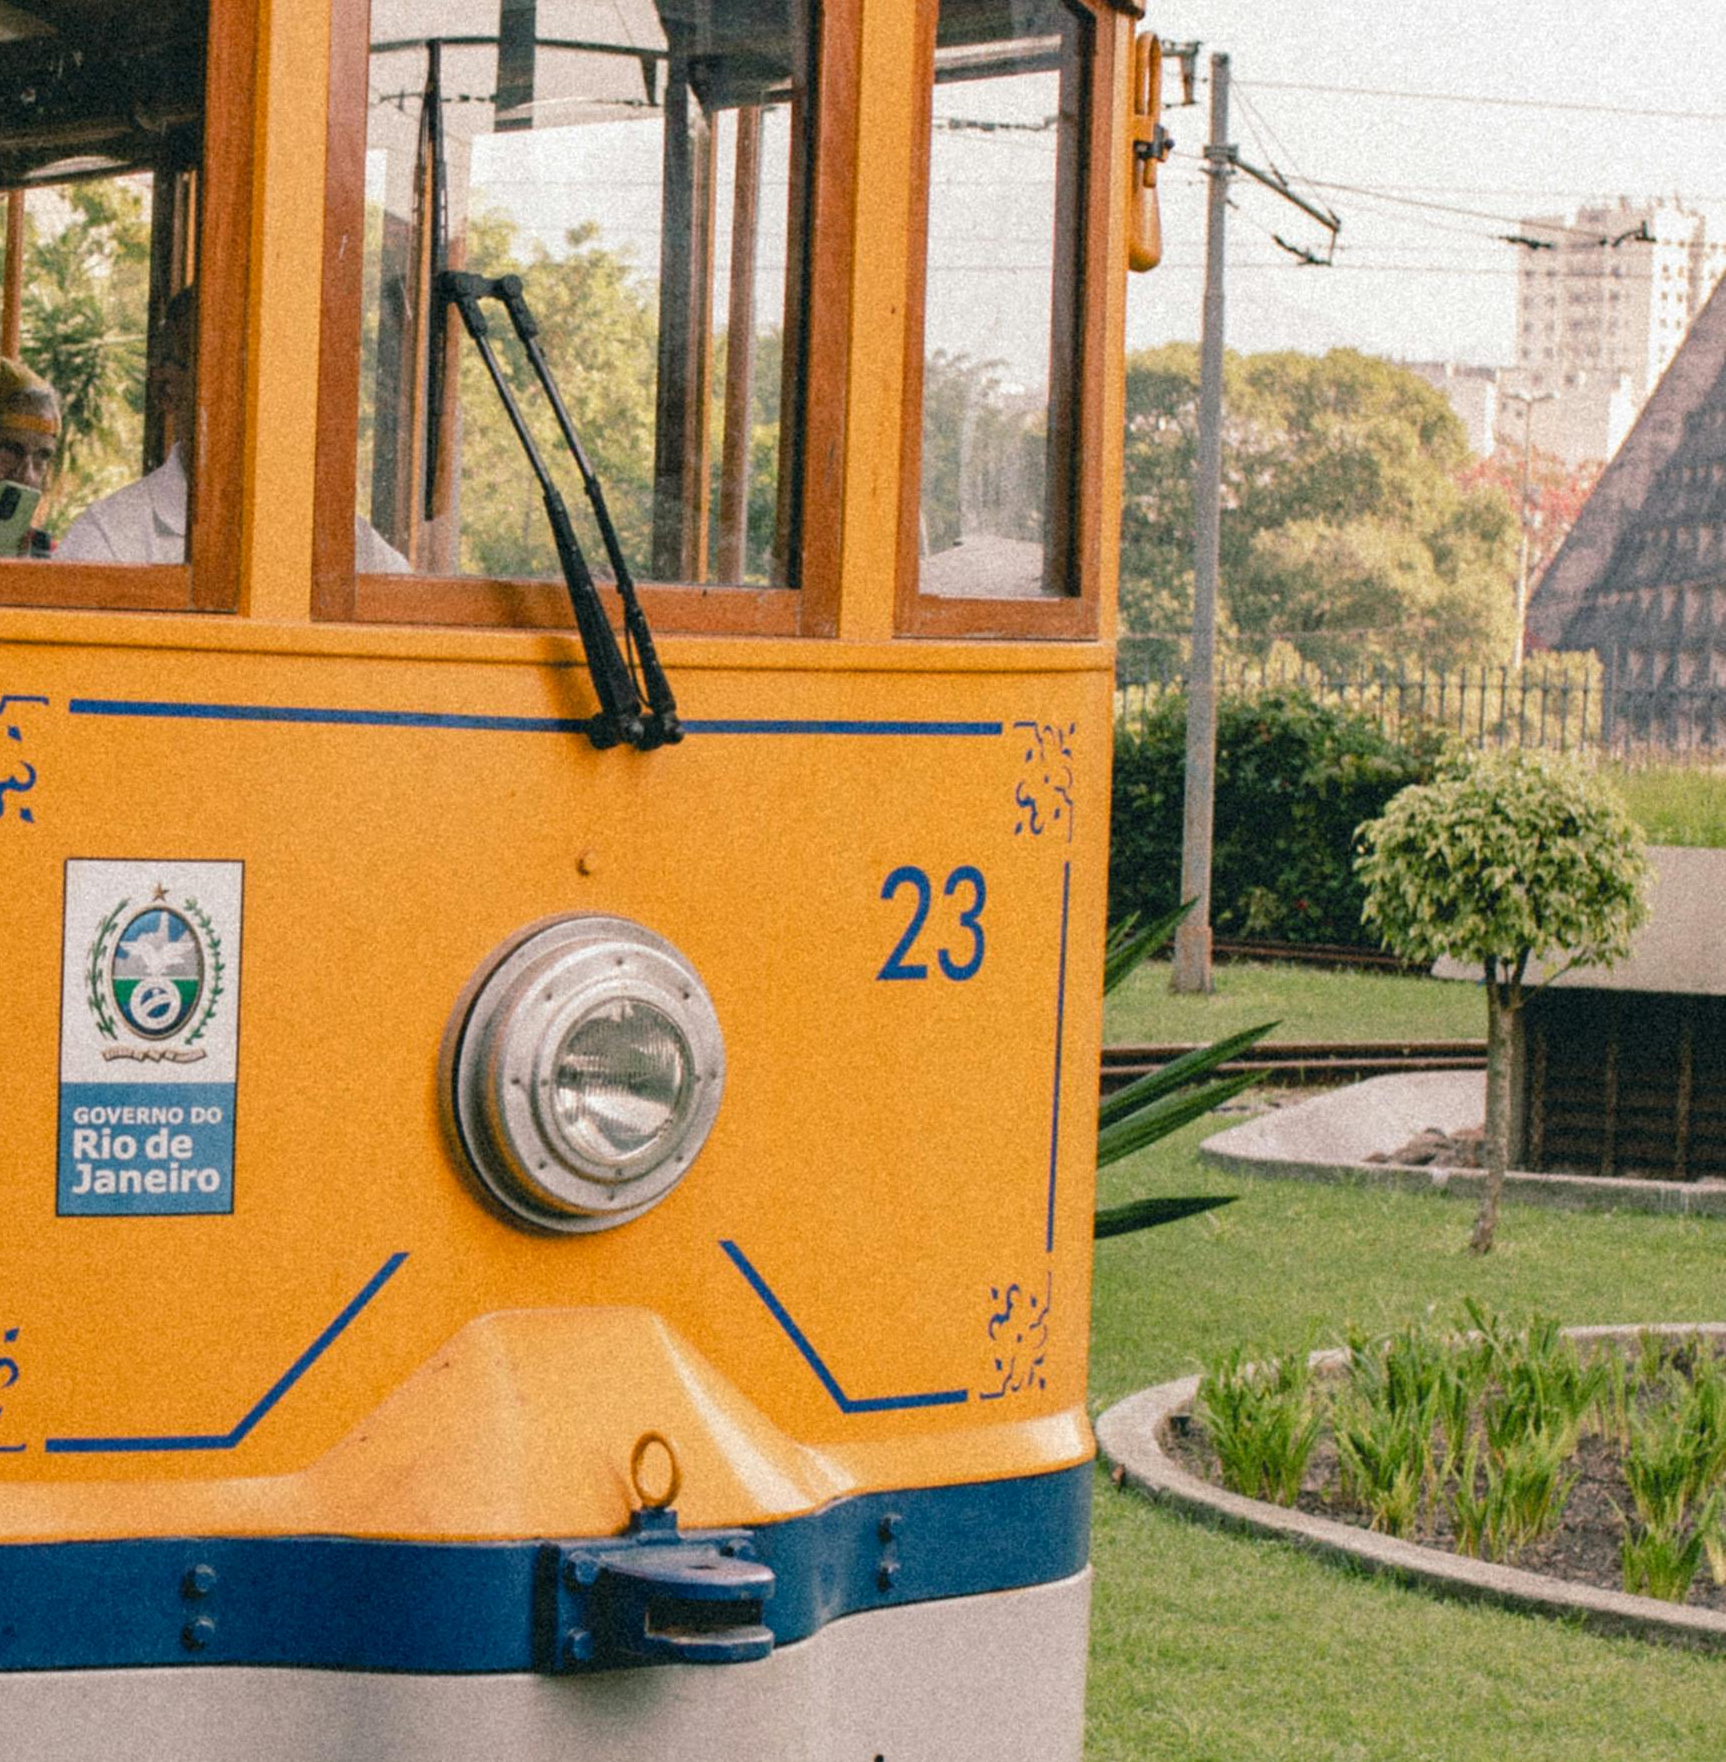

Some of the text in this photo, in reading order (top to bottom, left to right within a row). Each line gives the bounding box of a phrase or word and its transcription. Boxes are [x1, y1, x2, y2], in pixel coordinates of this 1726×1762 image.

[876, 865, 987, 981] 23
[73, 1106, 223, 1125] GOVERNO DO
[73, 1127, 194, 1160] Rio de
[71, 1163, 221, 1195] Janeiro
